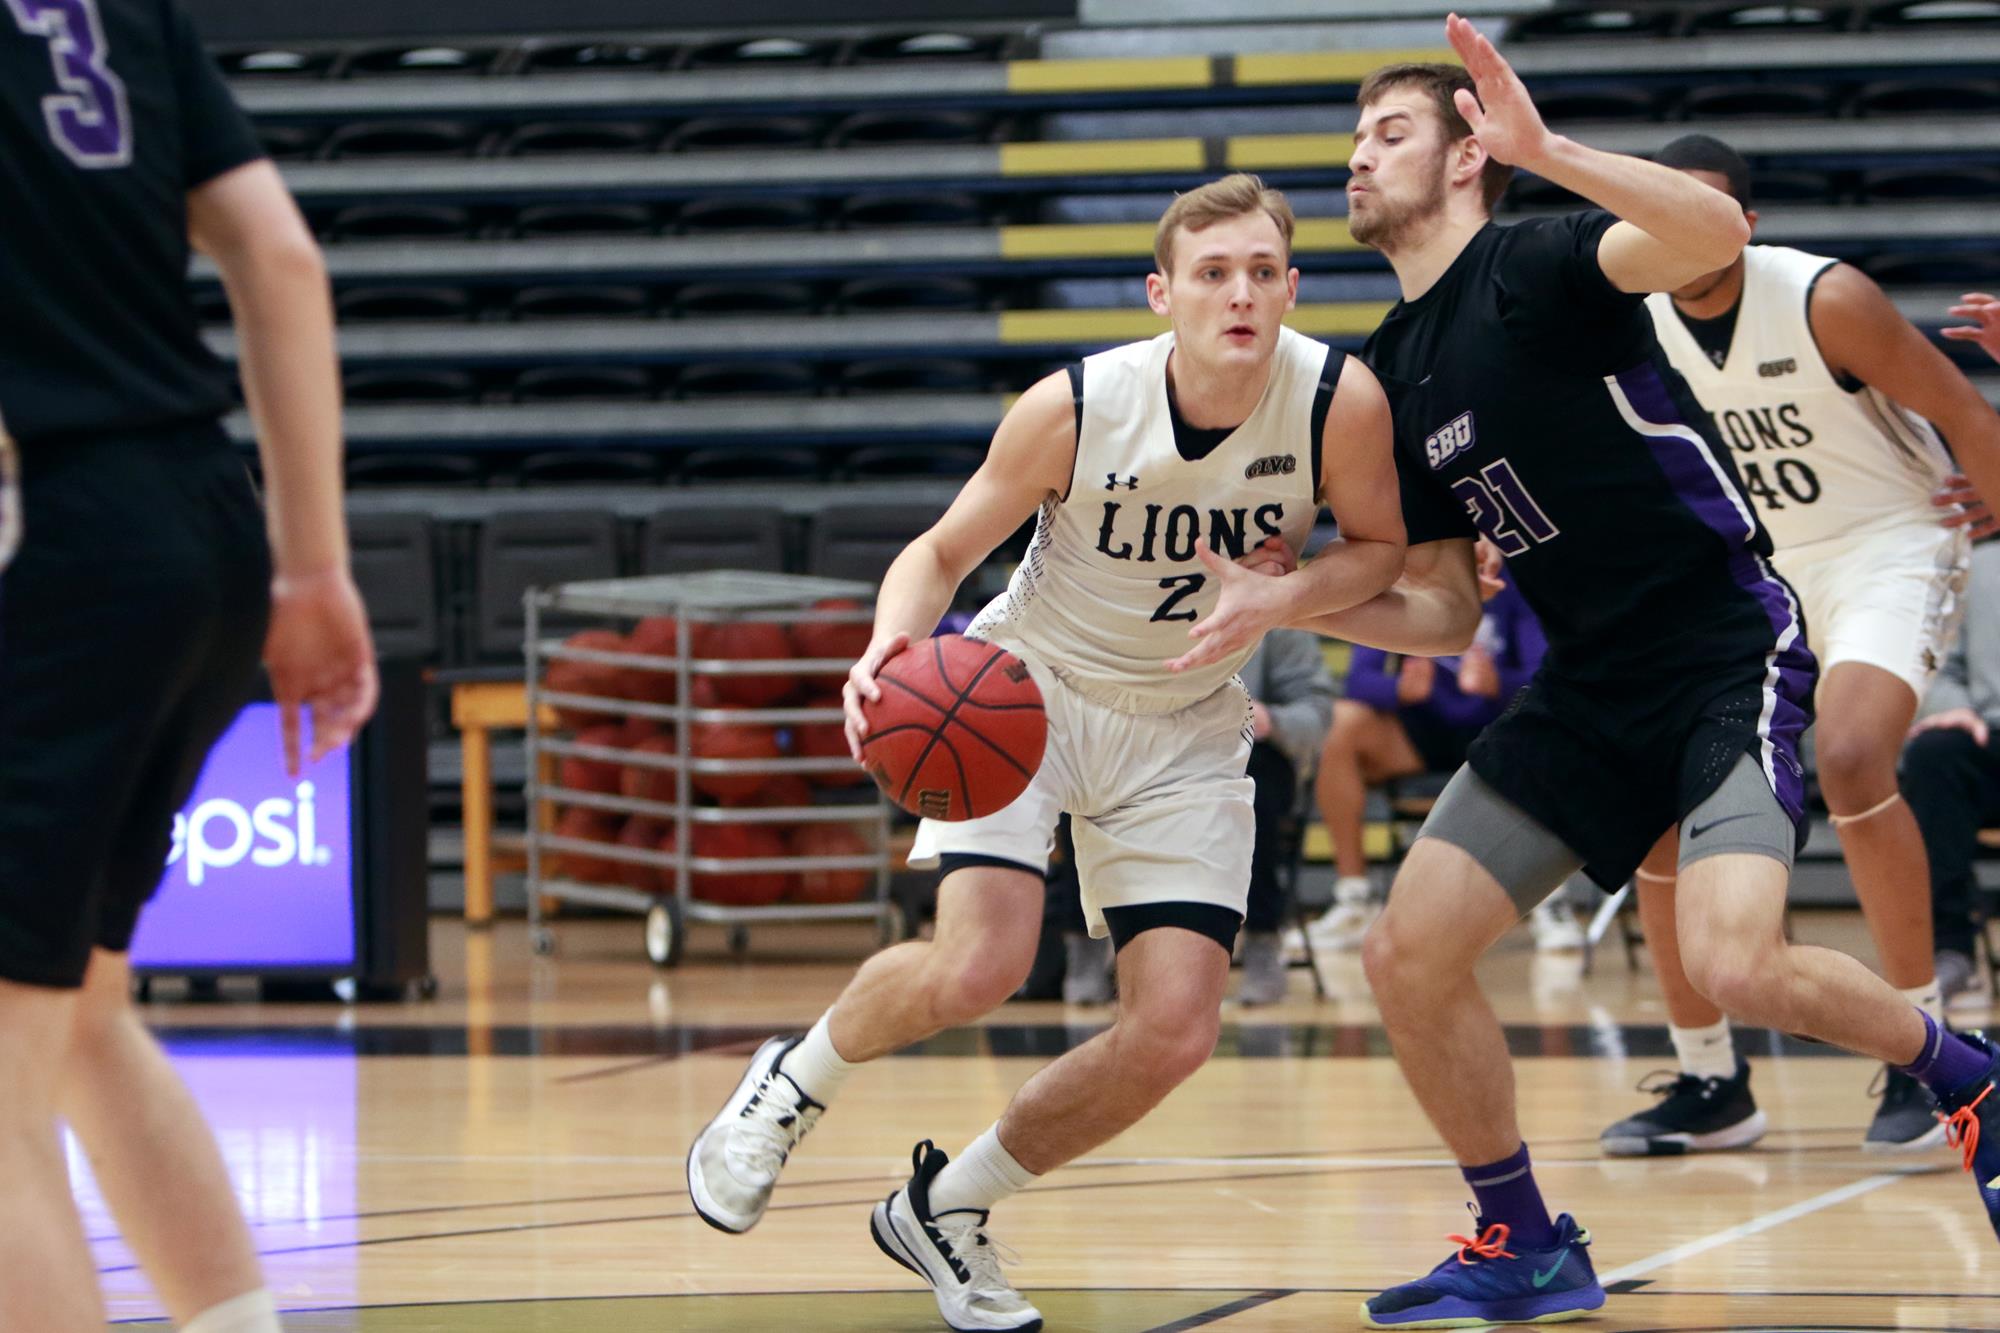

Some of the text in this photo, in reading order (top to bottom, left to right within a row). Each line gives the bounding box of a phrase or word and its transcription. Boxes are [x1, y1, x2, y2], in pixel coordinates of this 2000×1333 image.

[6, 0, 133, 169] 3
[1425, 410, 1476, 470] SBU
[1450, 457, 1560, 558] 21
[1746, 458, 1821, 509] 40
[1096, 501, 1284, 562] LIONS
[1150, 573, 1206, 622] 2
